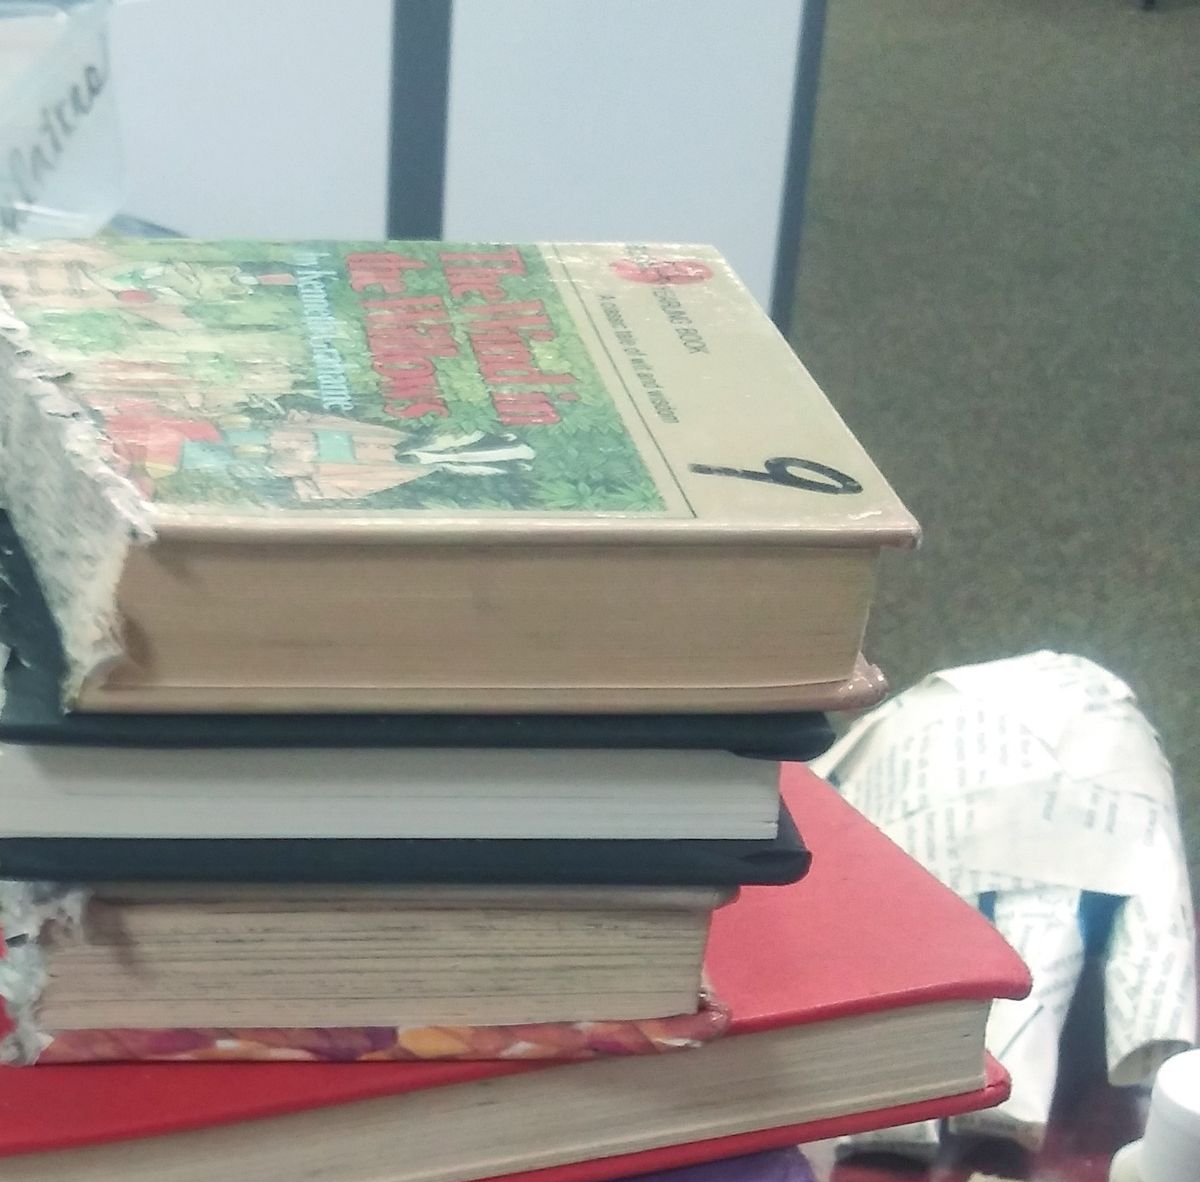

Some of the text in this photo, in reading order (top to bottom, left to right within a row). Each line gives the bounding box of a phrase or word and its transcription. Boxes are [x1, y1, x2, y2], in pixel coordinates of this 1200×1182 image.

[296, 270, 349, 335] Kenneth
[345, 252, 459, 419] the Willows
[437, 248, 582, 426] The Wind in
[309, 335, 360, 411] Grahame
[675, 328, 710, 355] BOOK
[637, 372, 663, 389] and
